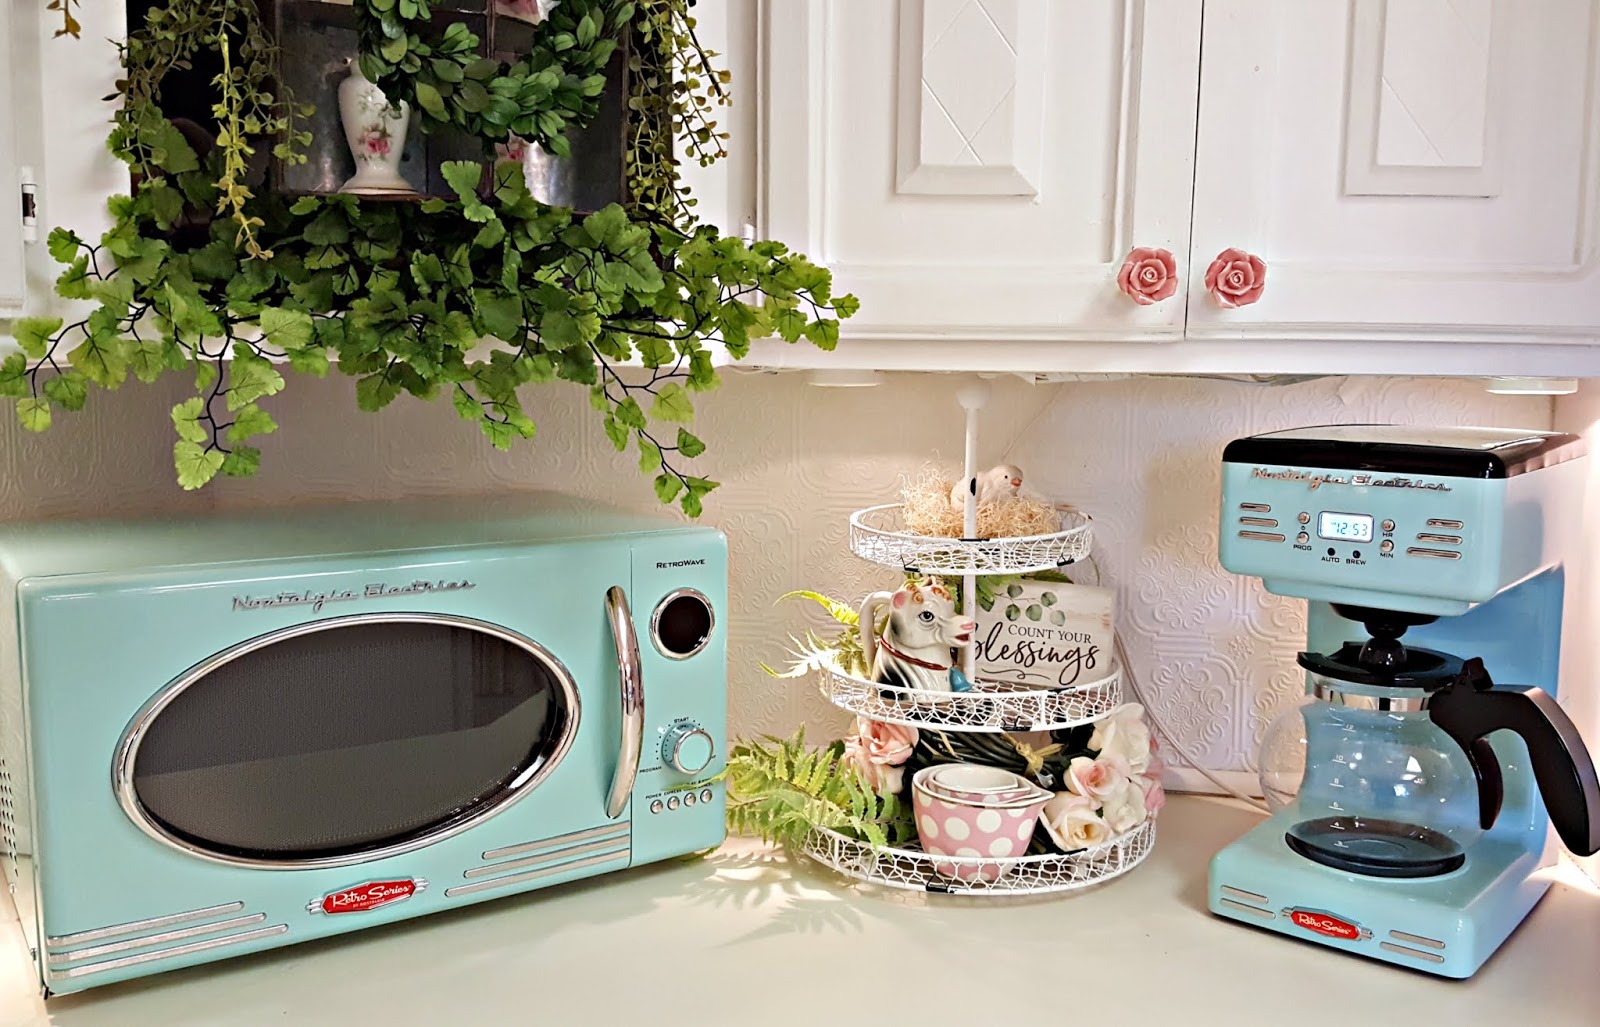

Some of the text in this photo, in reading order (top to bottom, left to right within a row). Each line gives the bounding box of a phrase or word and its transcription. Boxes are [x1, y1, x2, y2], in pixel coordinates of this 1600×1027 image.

[1252, 467, 1453, 492] Nostalgia Electrics
[1336, 522, 1368, 537] 12:53
[232, 579, 477, 612] Nostalgia Electrics
[1007, 624, 1092, 644] COUNT YOUR
[645, 792, 662, 800] POWER
[329, 885, 409, 908] Retro Series
[1298, 913, 1321, 927] Retro
[1321, 920, 1350, 935] Series
